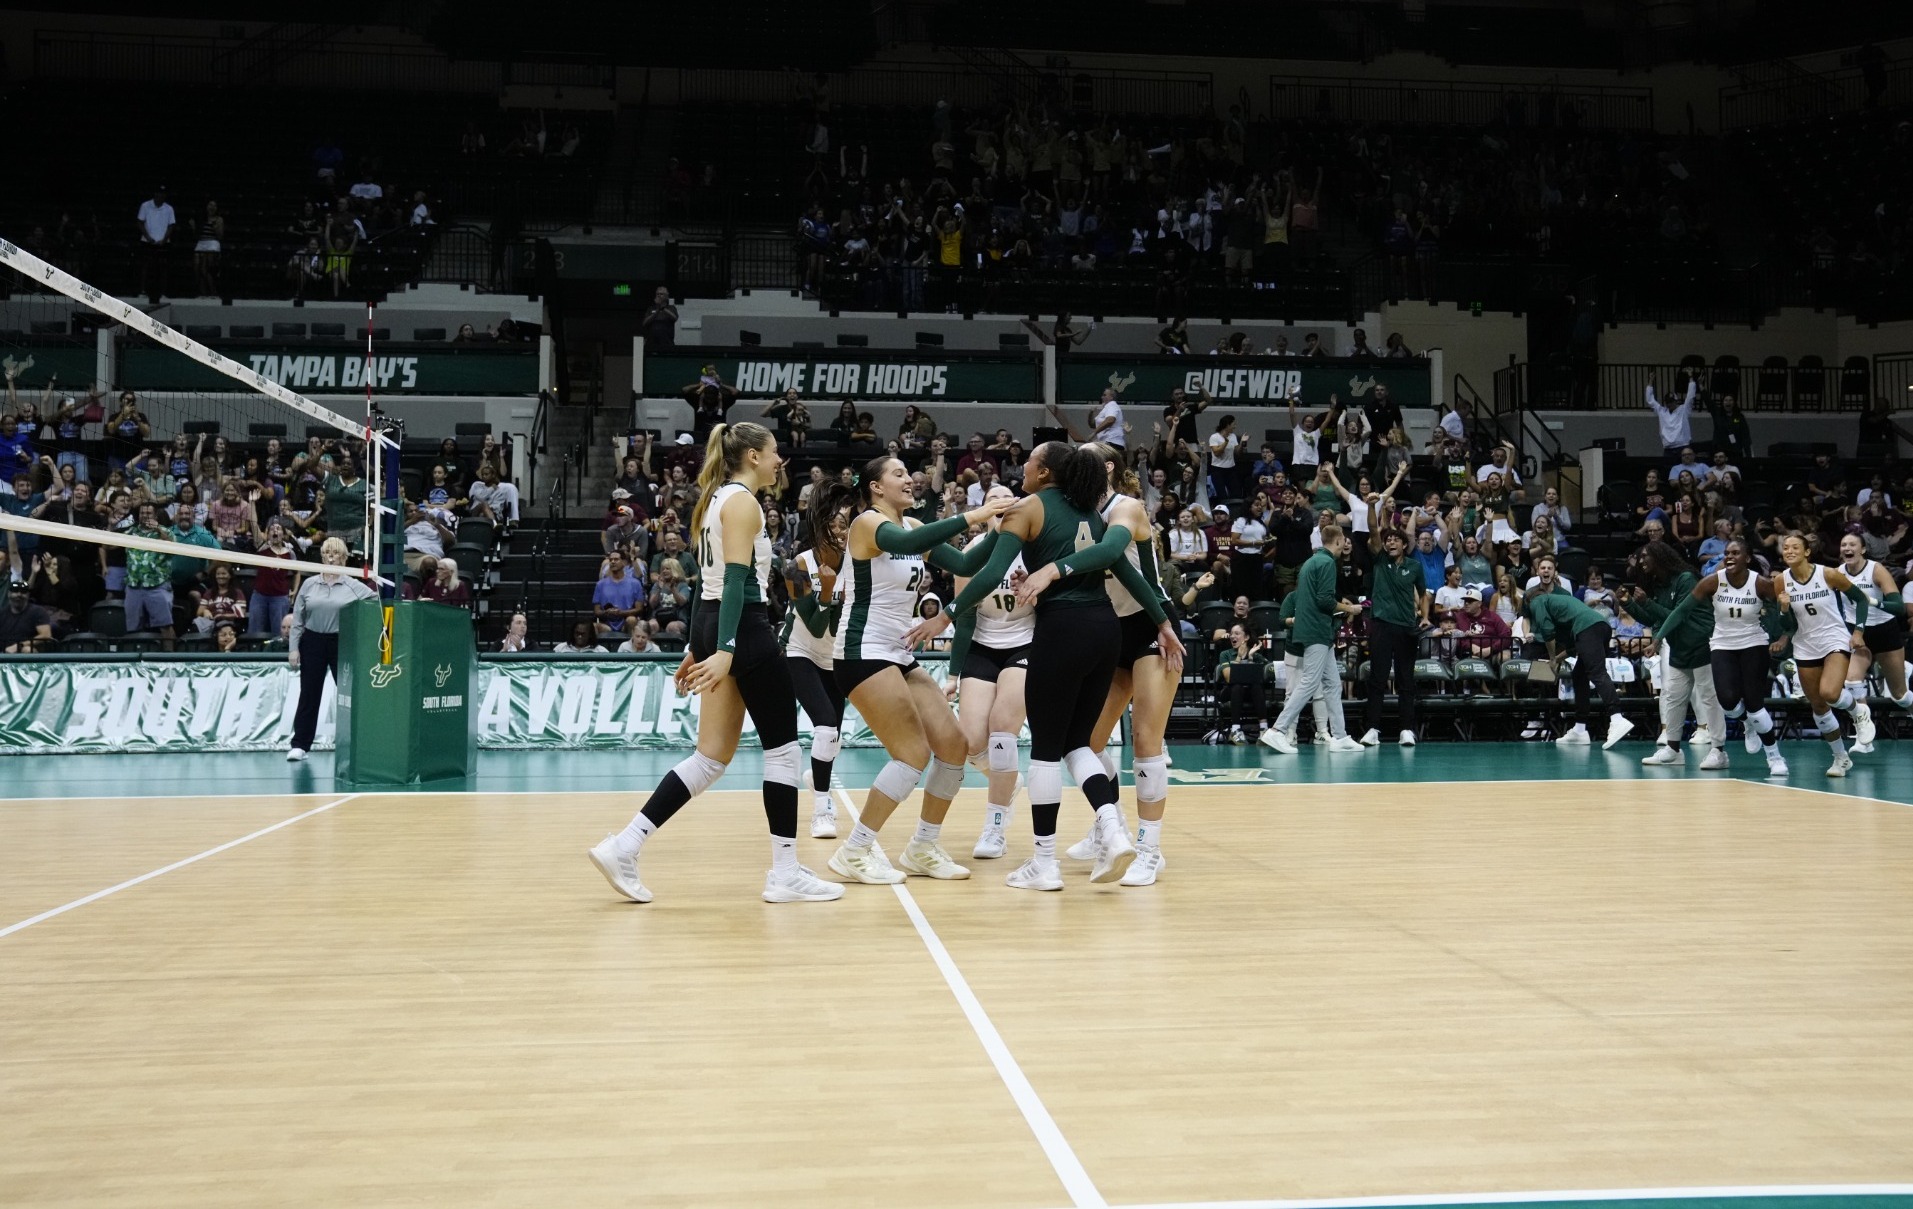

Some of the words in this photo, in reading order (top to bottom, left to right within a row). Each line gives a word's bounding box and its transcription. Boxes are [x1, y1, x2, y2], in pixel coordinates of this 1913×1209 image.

[524, 251, 565, 270] 23
[678, 254, 718, 273] 214
[249, 354, 336, 388] TAMPA
[341, 356, 418, 388] BAY'S
[736, 361, 806, 393] HOME
[812, 363, 860, 394] FOR
[866, 364, 948, 396] HOOPS
[1074, 521, 1095, 552] 4
[699, 526, 715, 569] 16
[906, 566, 924, 592] 21
[992, 594, 1016, 613] 18
[1717, 594, 1733, 604] SOUTH
[1734, 596, 1757, 605] FLORIDA
[1790, 593, 1804, 602] OUTH
[1805, 588, 1830, 600] FLORIDA
[1728, 607, 1742, 618] 11
[1804, 603, 1818, 616] 6
[66, 676, 265, 738] SOUTH
[422, 697, 439, 709] SOUTH
